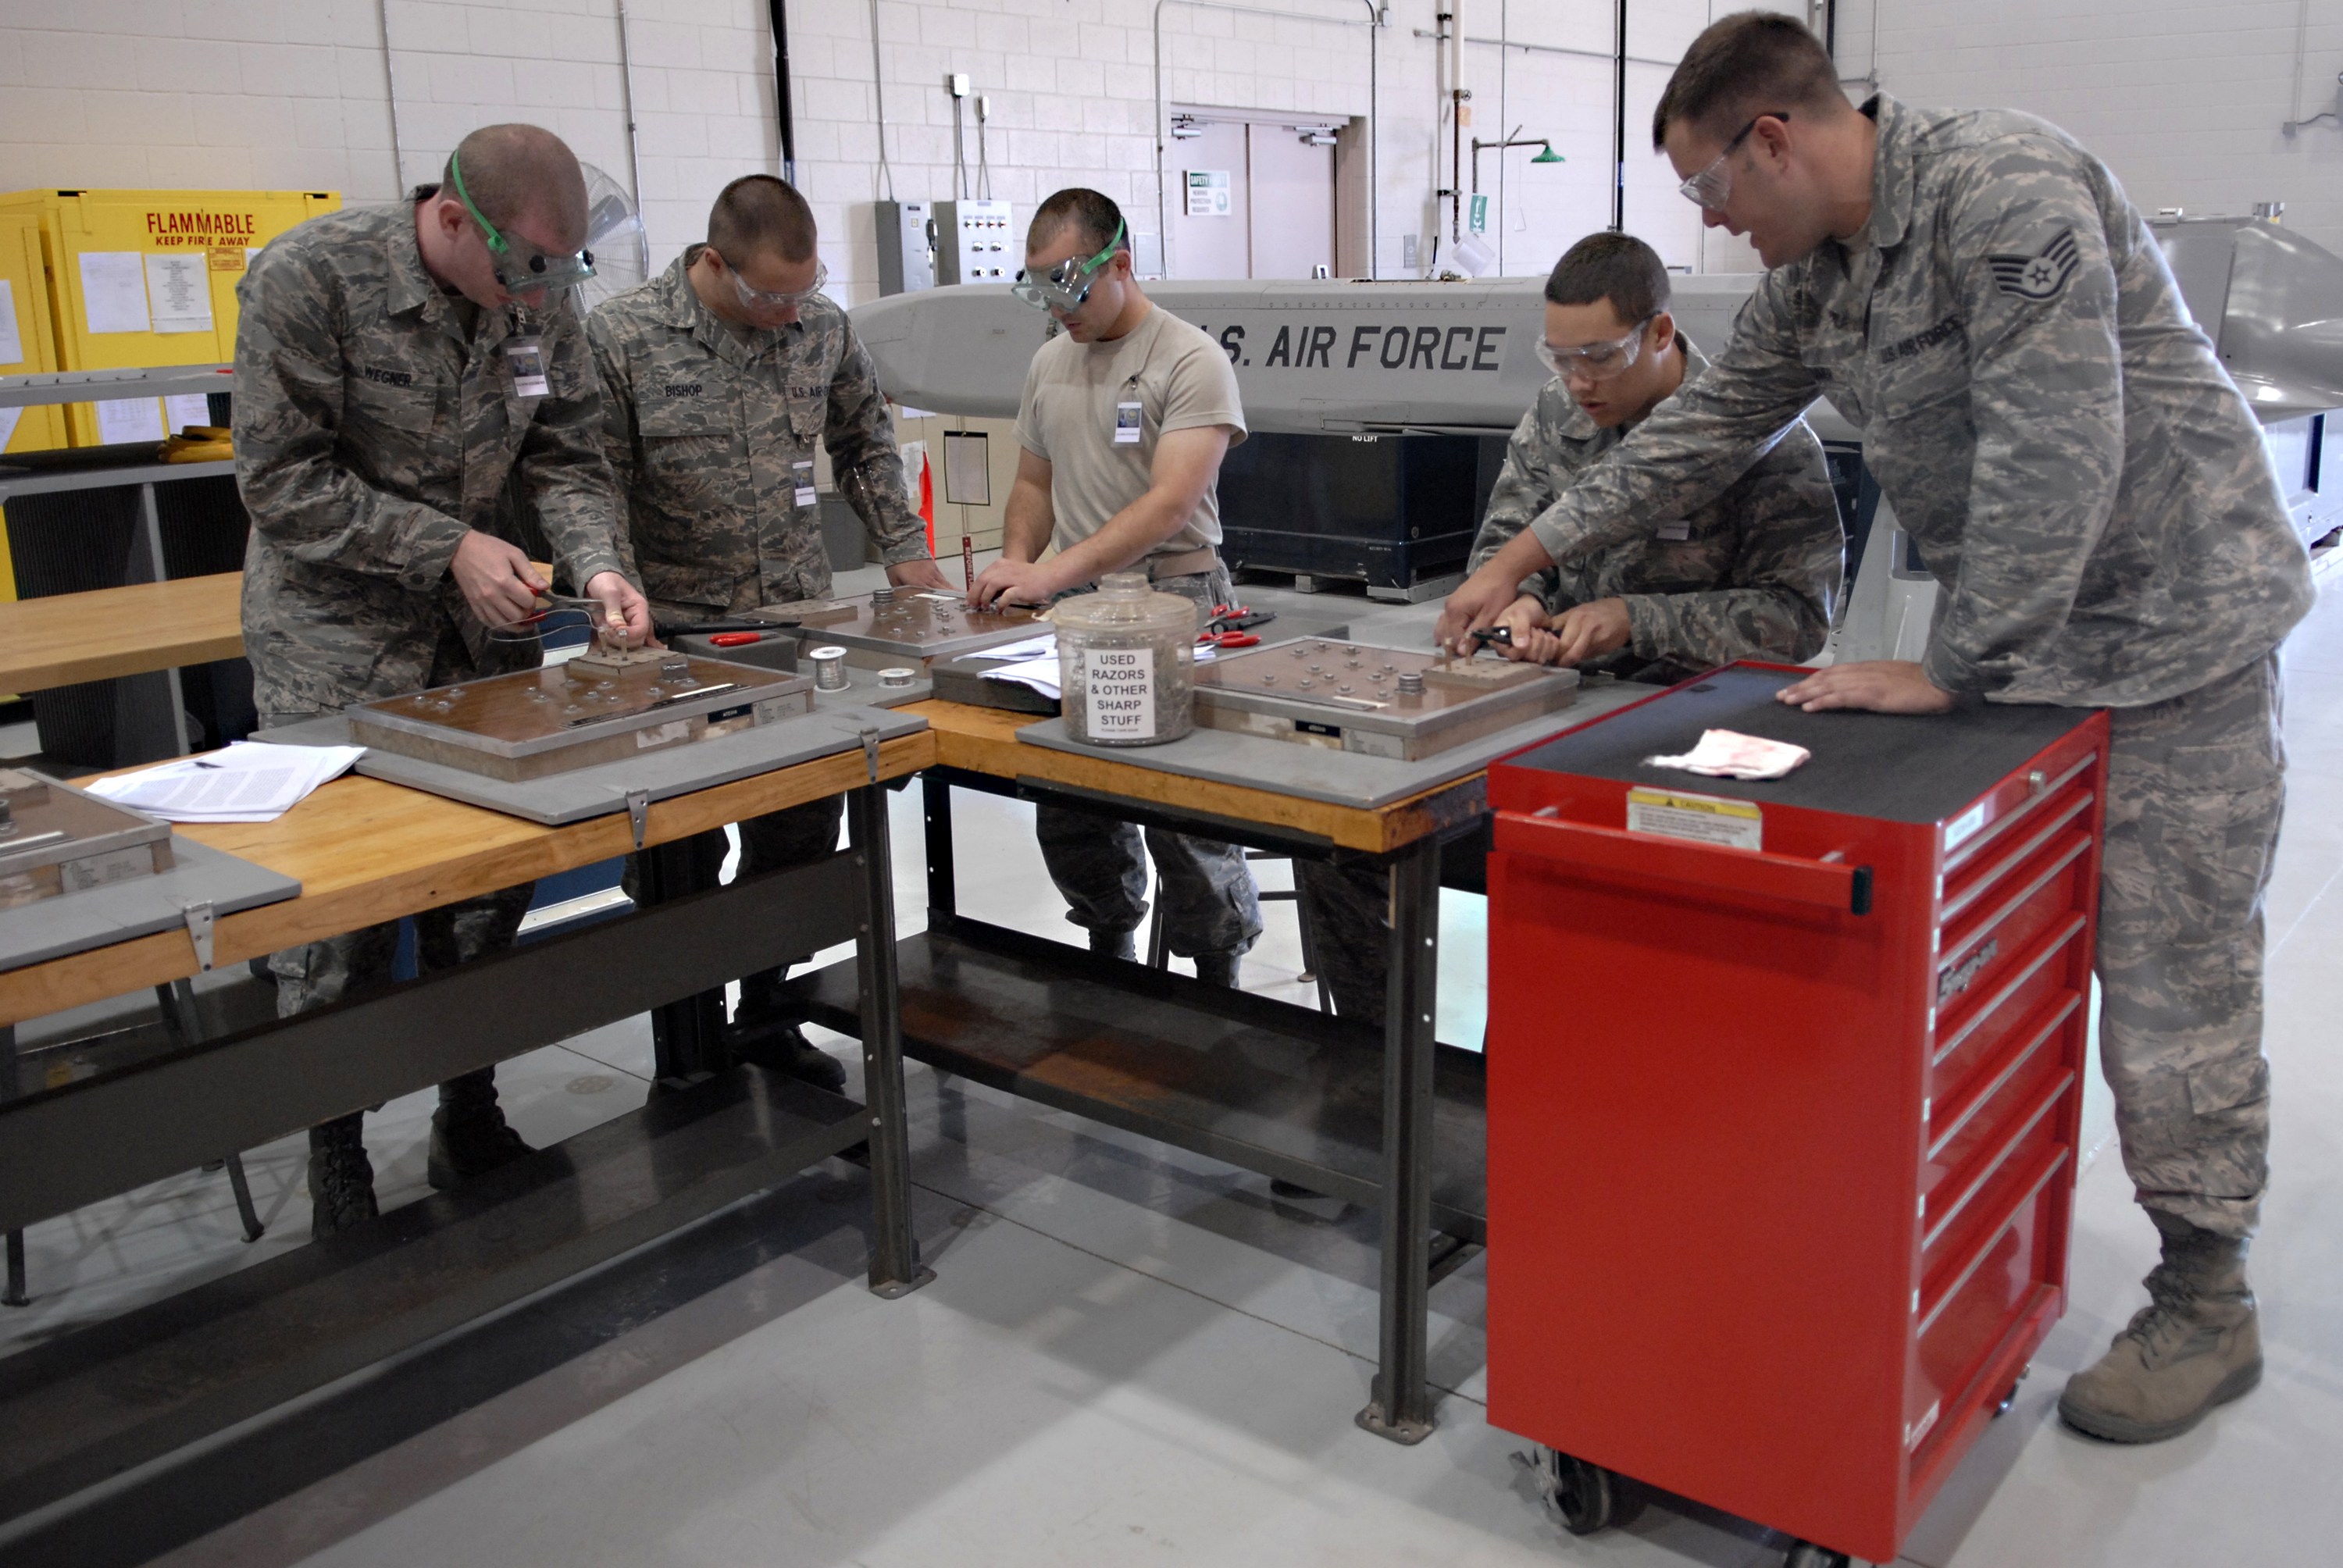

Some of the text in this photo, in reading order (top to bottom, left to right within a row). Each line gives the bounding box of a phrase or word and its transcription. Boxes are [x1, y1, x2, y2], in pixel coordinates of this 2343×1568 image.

[1190, 175, 1208, 185] SAFETY
[147, 212, 255, 233] FLAMMABLE
[156, 236, 250, 246] KEEP FIRE AWAY
[1265, 326, 1337, 368] AIR
[1347, 326, 1507, 371] FORCE
[365, 365, 412, 387] WEGNER
[665, 384, 702, 397] BISHOP
[965, 547, 973, 573] BEFORE
[1100, 654, 1136, 665] USED
[1092, 669, 1146, 681] RAZORS
[1090, 684, 1148, 696] & OTHER
[1097, 700, 1142, 711] SHARP
[1101, 715, 1142, 726] STUFF
[1681, 800, 1716, 814] CAUTION
